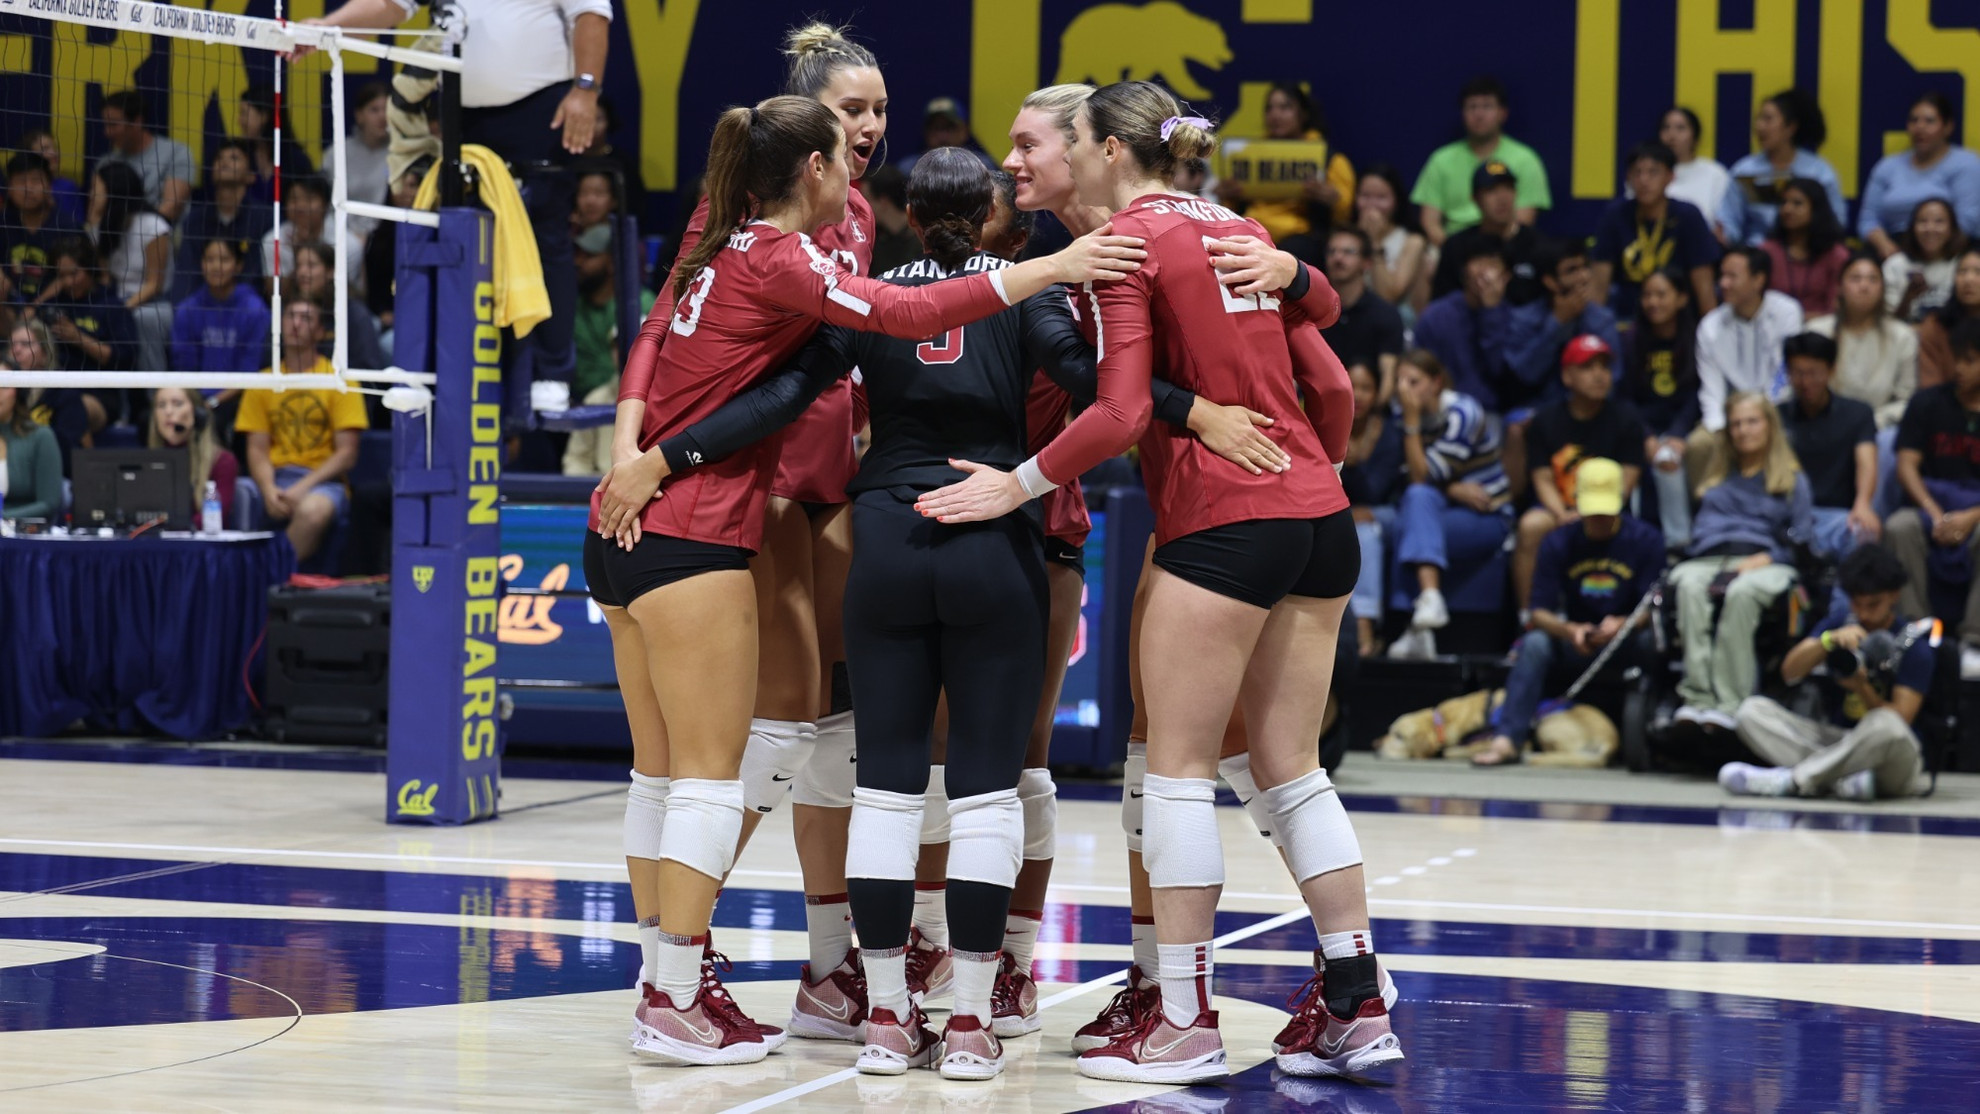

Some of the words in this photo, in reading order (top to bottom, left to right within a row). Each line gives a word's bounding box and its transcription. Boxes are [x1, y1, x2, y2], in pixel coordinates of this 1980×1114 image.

[96, 0, 119, 21] BEARS
[1141, 199, 1248, 223] STANFOR
[880, 253, 1016, 281] STANORD
[467, 281, 502, 525] GOLDEN
[461, 556, 499, 761] BEARS
[396, 779, 439, 816] Cal
